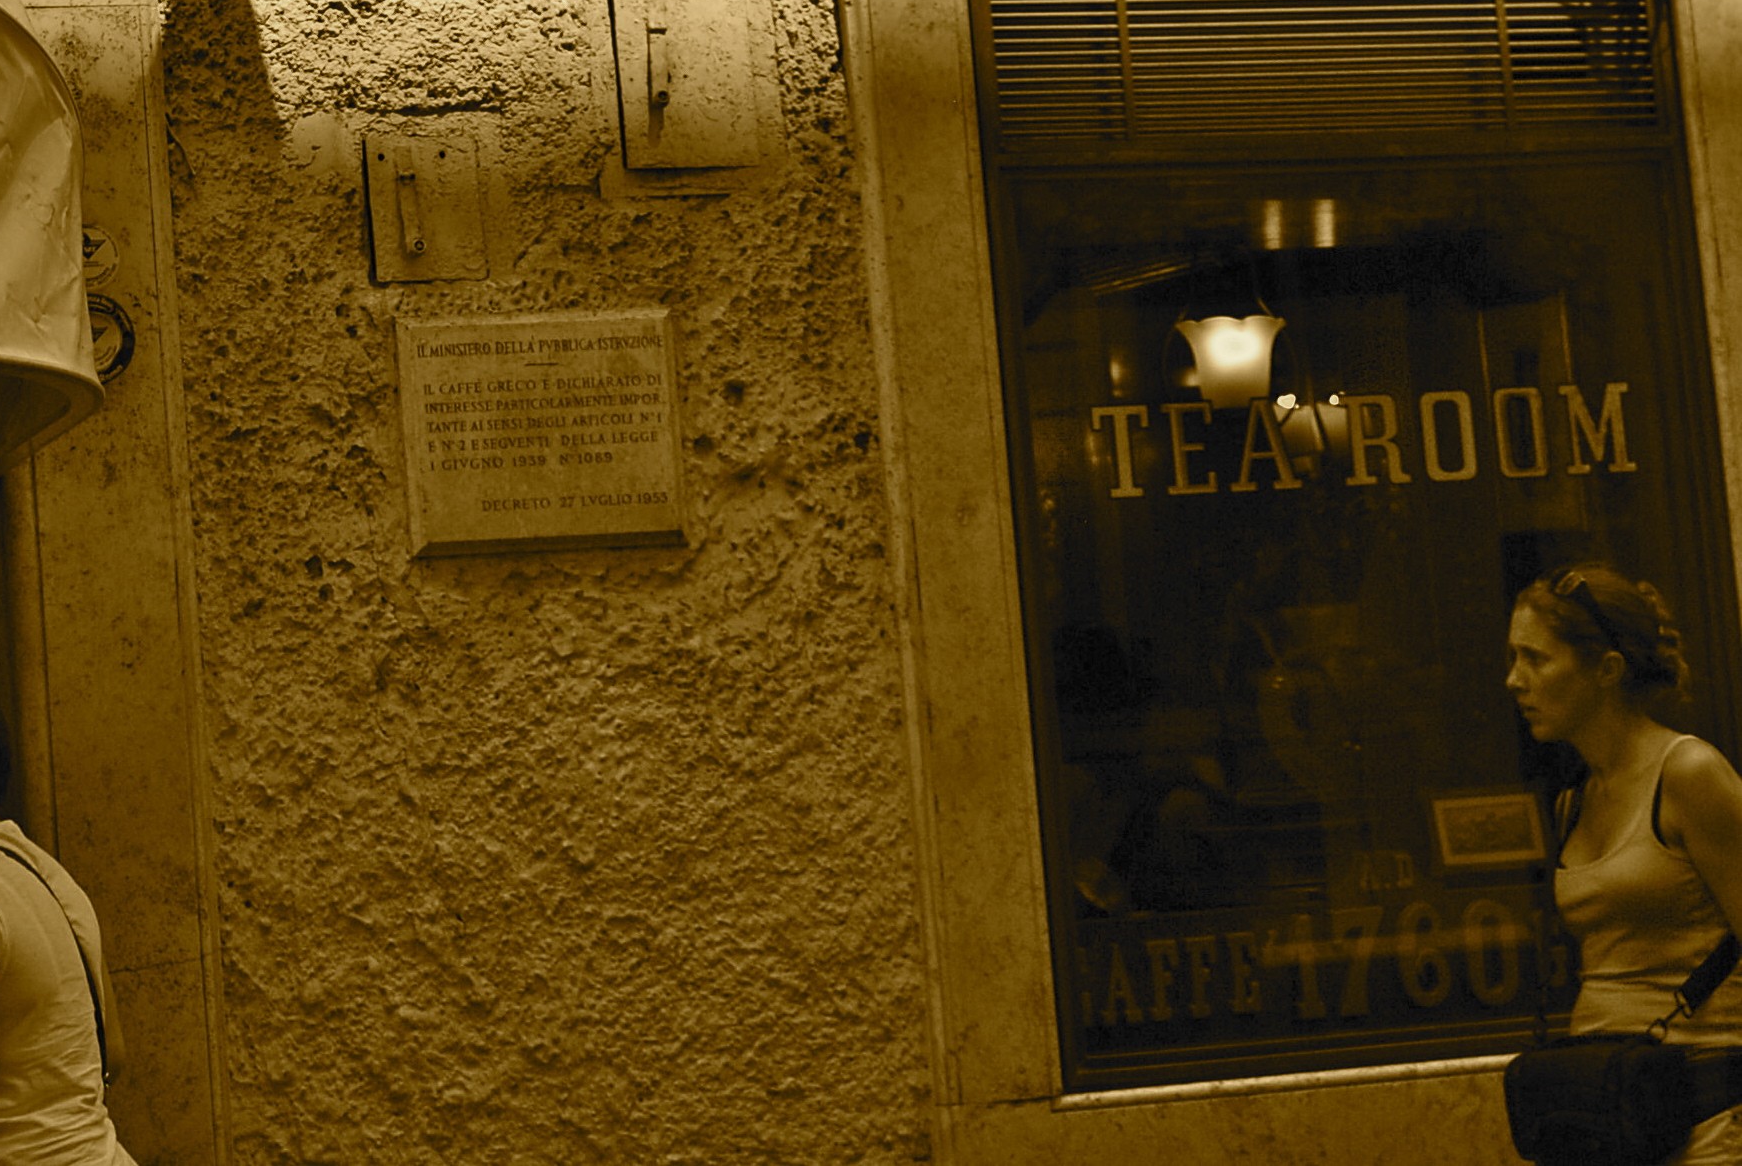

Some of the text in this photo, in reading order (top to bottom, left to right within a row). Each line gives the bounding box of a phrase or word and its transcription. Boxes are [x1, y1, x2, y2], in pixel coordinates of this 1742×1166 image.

[429, 341, 491, 358] MINISTERO
[495, 339, 535, 355] DELLA
[423, 383, 435, 396] IL
[487, 379, 537, 393] GRECO
[556, 374, 642, 390] DICHIARATO
[646, 373, 662, 386] DI
[424, 400, 493, 415] INTERESSE
[496, 394, 616, 412] PARTICOLARMENTE
[426, 420, 467, 434] TANTE
[470, 420, 484, 433] AI
[486, 417, 523, 431] SENSI
[527, 415, 566, 430] DEGLI
[571, 412, 633, 427] ARTICOLI
[428, 440, 436, 453] E
[560, 432, 607, 447] DELLA
[611, 430, 659, 444] LEGGE
[1091, 382, 1638, 499] TEA ROOM
[512, 454, 546, 468] 1939
[481, 497, 551, 512] DECRETO
[558, 495, 576, 509] 27
[1289, 898, 1519, 1021] 1760
